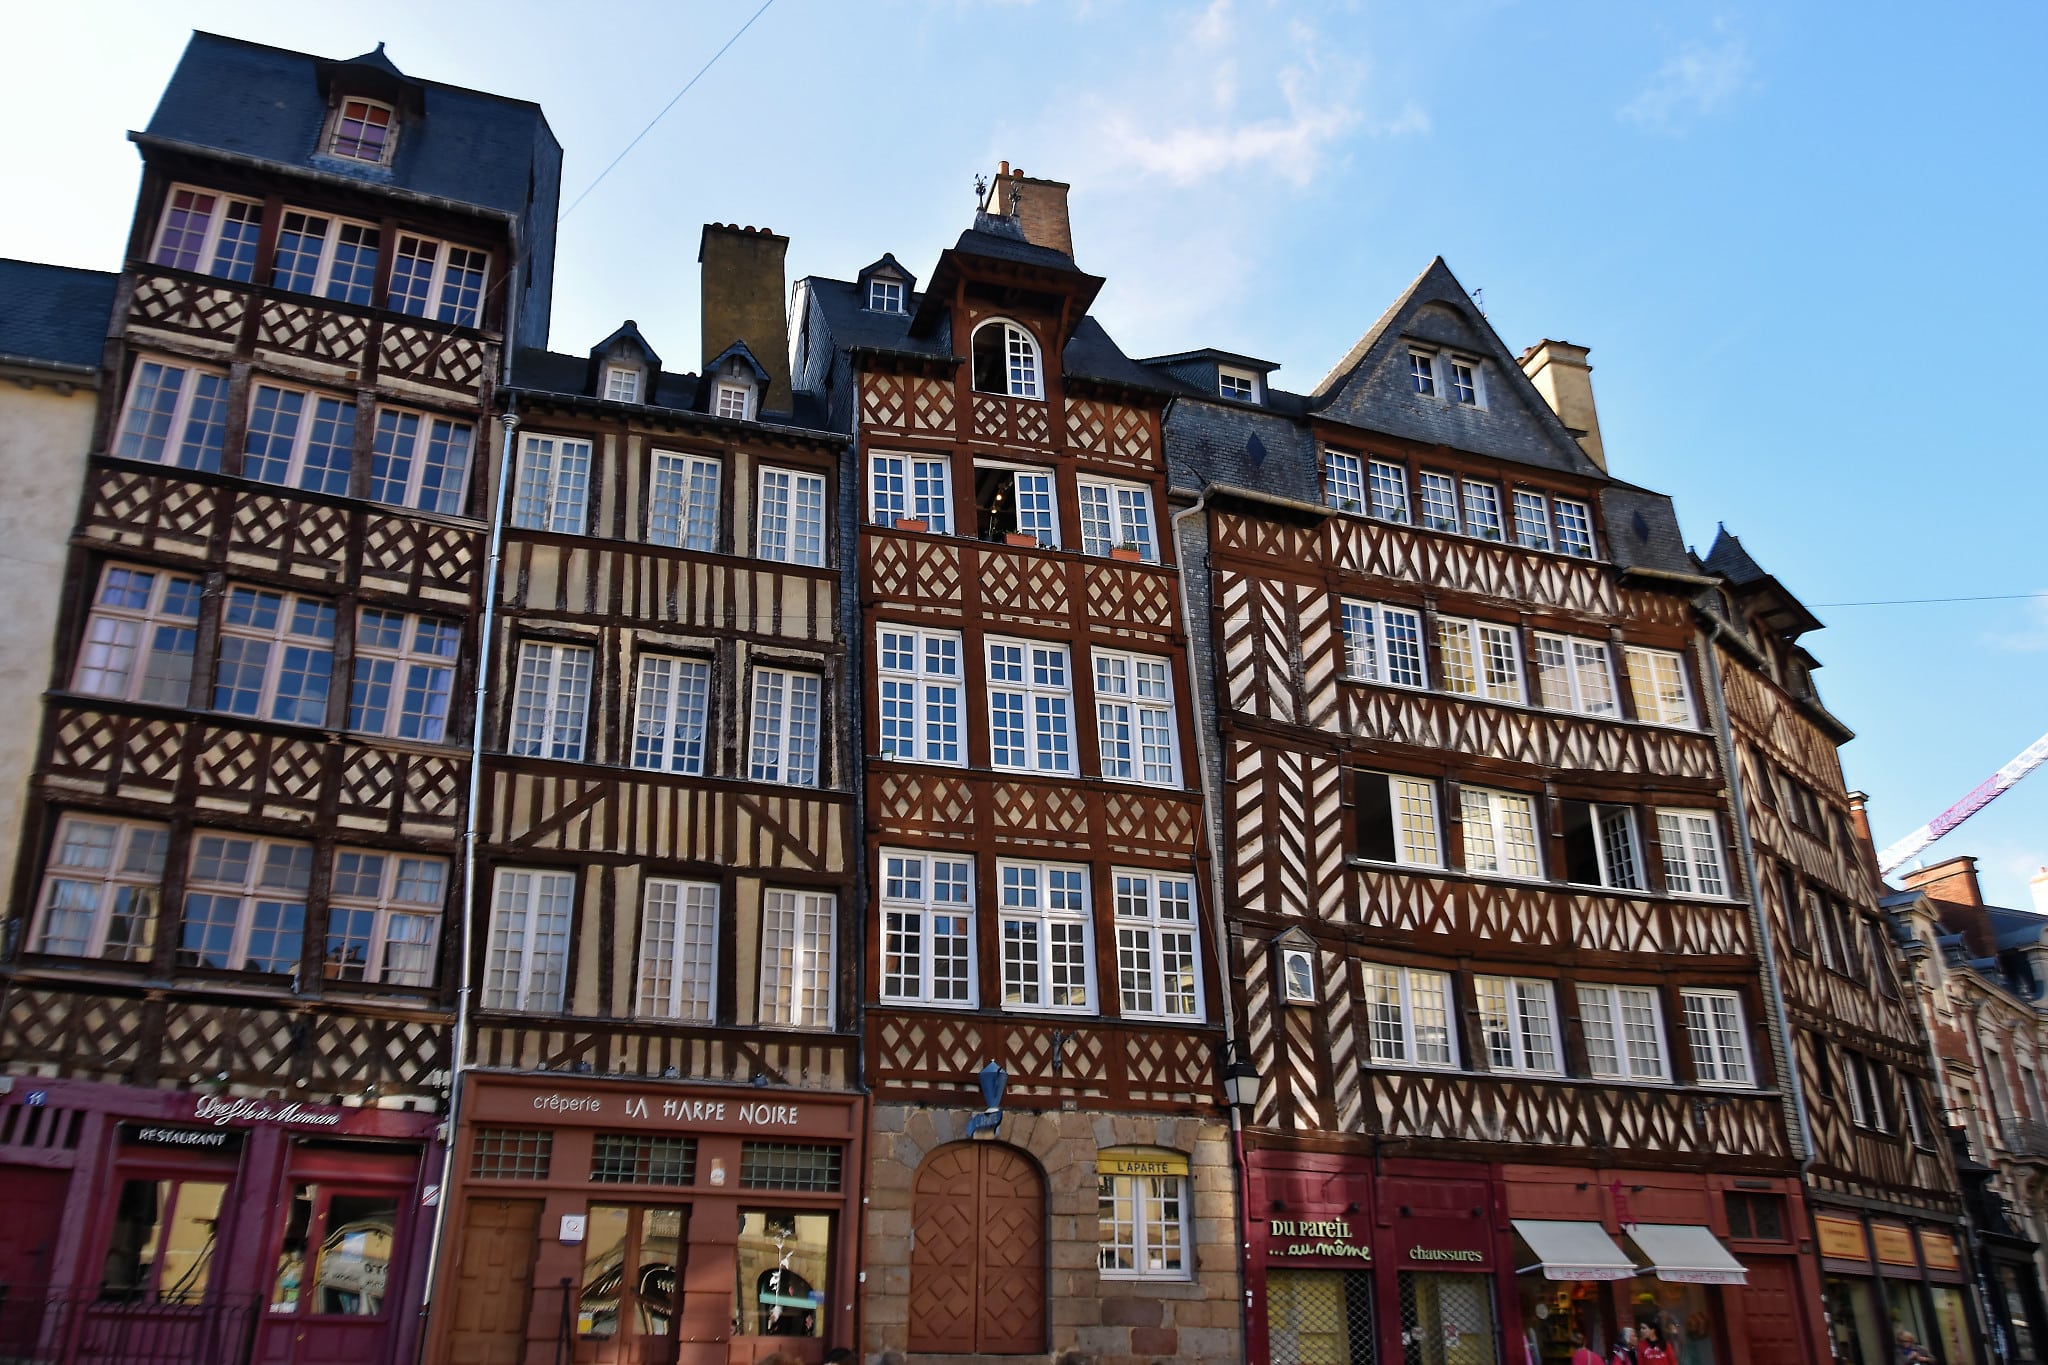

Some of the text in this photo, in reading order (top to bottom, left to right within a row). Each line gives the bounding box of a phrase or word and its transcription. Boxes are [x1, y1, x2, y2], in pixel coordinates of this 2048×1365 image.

[267, 1102, 340, 1126] Maman
[533, 1094, 601, 1114] crêperie
[625, 1098, 799, 1126] LA HARPE NOIRE
[139, 1127, 227, 1146] RESTAURANT
[1117, 1161, 1169, 1174] L'APARTÉ
[1315, 1239, 1372, 1261] même
[1409, 1244, 1483, 1262] chaussures
